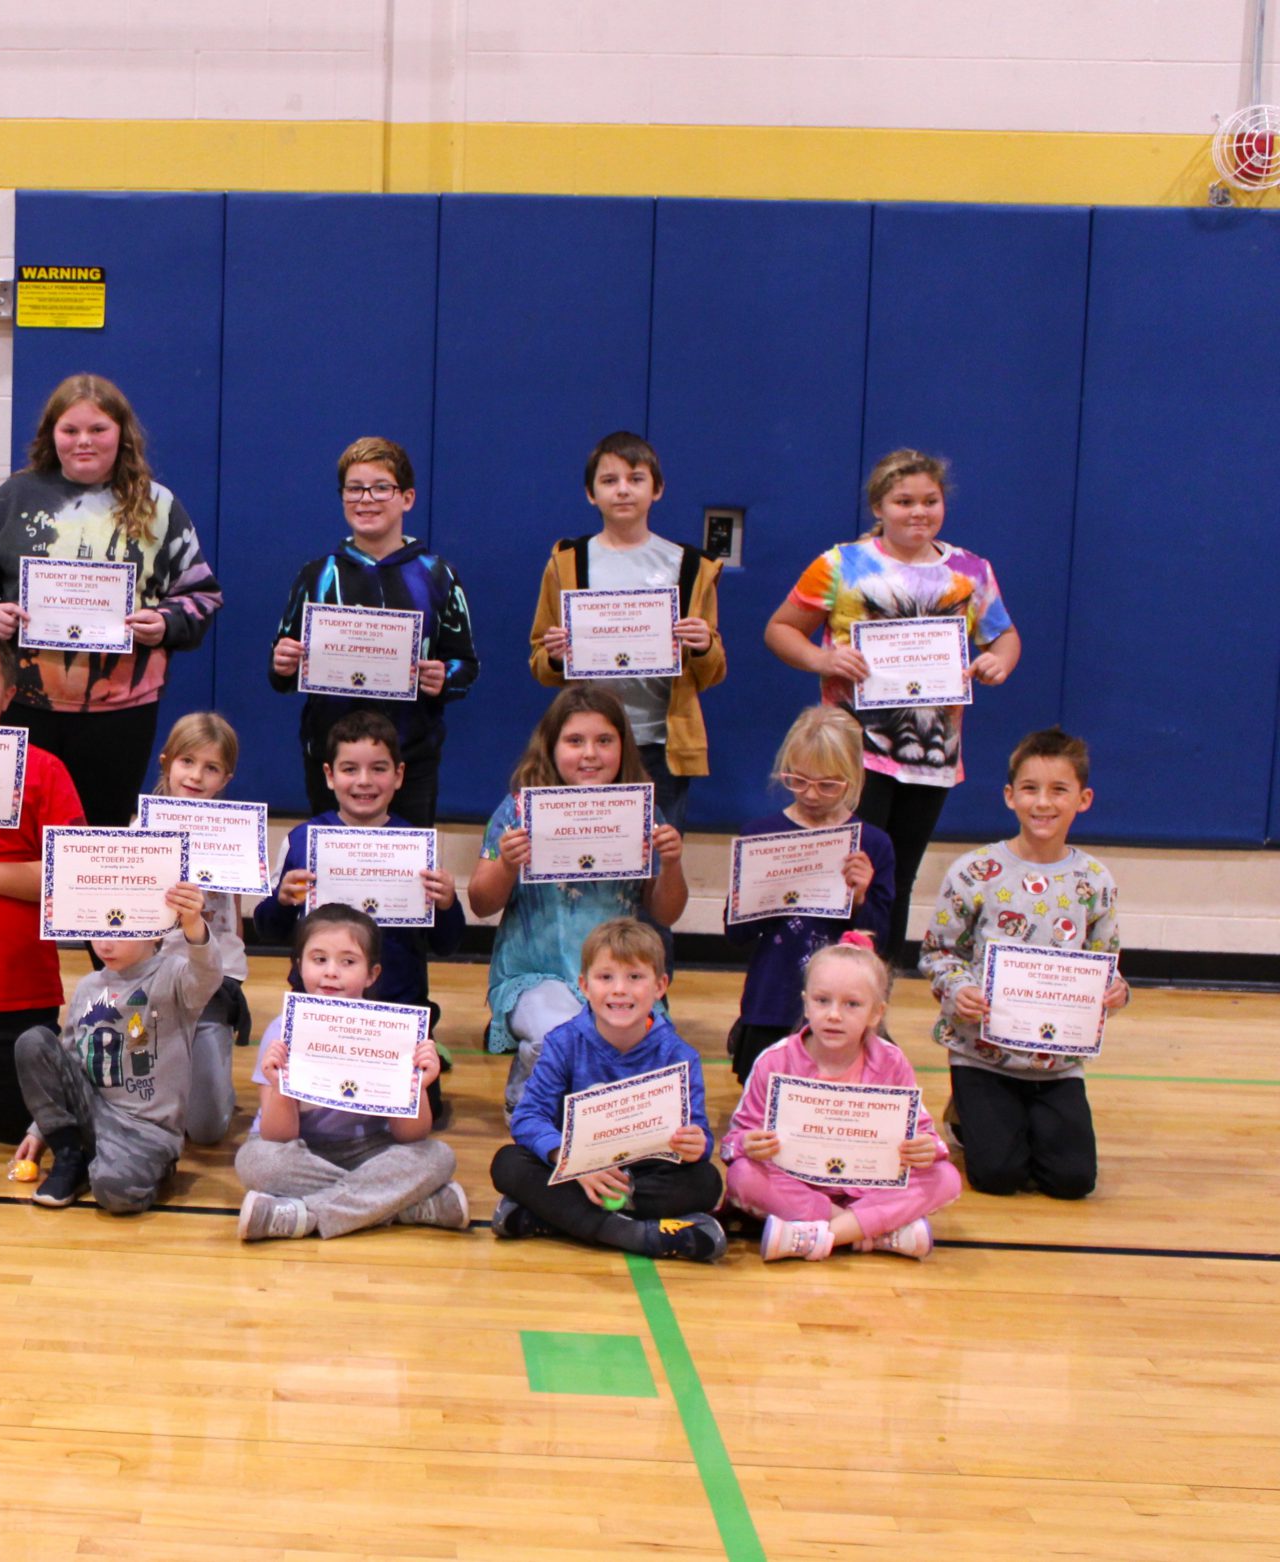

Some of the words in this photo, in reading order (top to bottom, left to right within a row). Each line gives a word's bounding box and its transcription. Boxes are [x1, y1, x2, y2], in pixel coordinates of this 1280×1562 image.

[22, 266, 101, 280] WARNING
[35, 572, 68, 580] STUDENT
[61, 598, 109, 606] WIEDEMANN
[320, 620, 353, 628] STUDENT
[593, 626, 620, 634] GAUGE
[623, 625, 651, 633] KNAPP
[325, 644, 345, 652] KYLE
[348, 645, 397, 655] ZIMMERMAN
[874, 656, 900, 664] SAYDE
[903, 653, 950, 662] CRAWFORD
[540, 801, 577, 809] STUDENT
[591, 800, 605, 808] THE
[554, 827, 592, 836] ADELYN
[595, 826, 620, 834] ROWE
[64, 846, 105, 854] STUDENT
[108, 846, 118, 854] OF
[121, 846, 138, 854] THE
[141, 846, 172, 854] MONTH
[204, 842, 241, 852] BRYANT
[361, 869, 413, 877] ZIMMERMAN
[766, 868, 790, 878] ADAH
[77, 875, 118, 885] ROBERT
[121, 876, 157, 885] MYERS
[1004, 961, 1041, 971] STUDENT
[1044, 964, 1053, 972] OF
[1055, 965, 1070, 973] THE
[1073, 967, 1101, 976] MONTH
[1003, 988, 1033, 998] GAVIN
[1036, 990, 1095, 1004] SANTAMARIA
[303, 1012, 344, 1024] STUDENT
[346, 1017, 357, 1025] OF
[359, 1018, 376, 1027] THE
[379, 1020, 409, 1031] MONTH
[329, 1026, 362, 1034] OCTOBER
[308, 1042, 345, 1054] ABIGAIL
[350, 1047, 398, 1059] SVENSON
[125, 1077, 156, 1094] Gear
[788, 1093, 831, 1105] STUDENT
[834, 1097, 844, 1106] OF
[847, 1099, 864, 1108] THE
[868, 1101, 900, 1112] MONTH
[594, 1124, 629, 1140] BROOKS
[632, 1116, 663, 1133] HOUTZ
[803, 1124, 834, 1135] EMILY
[837, 1126, 878, 1138] O'BRIEN
